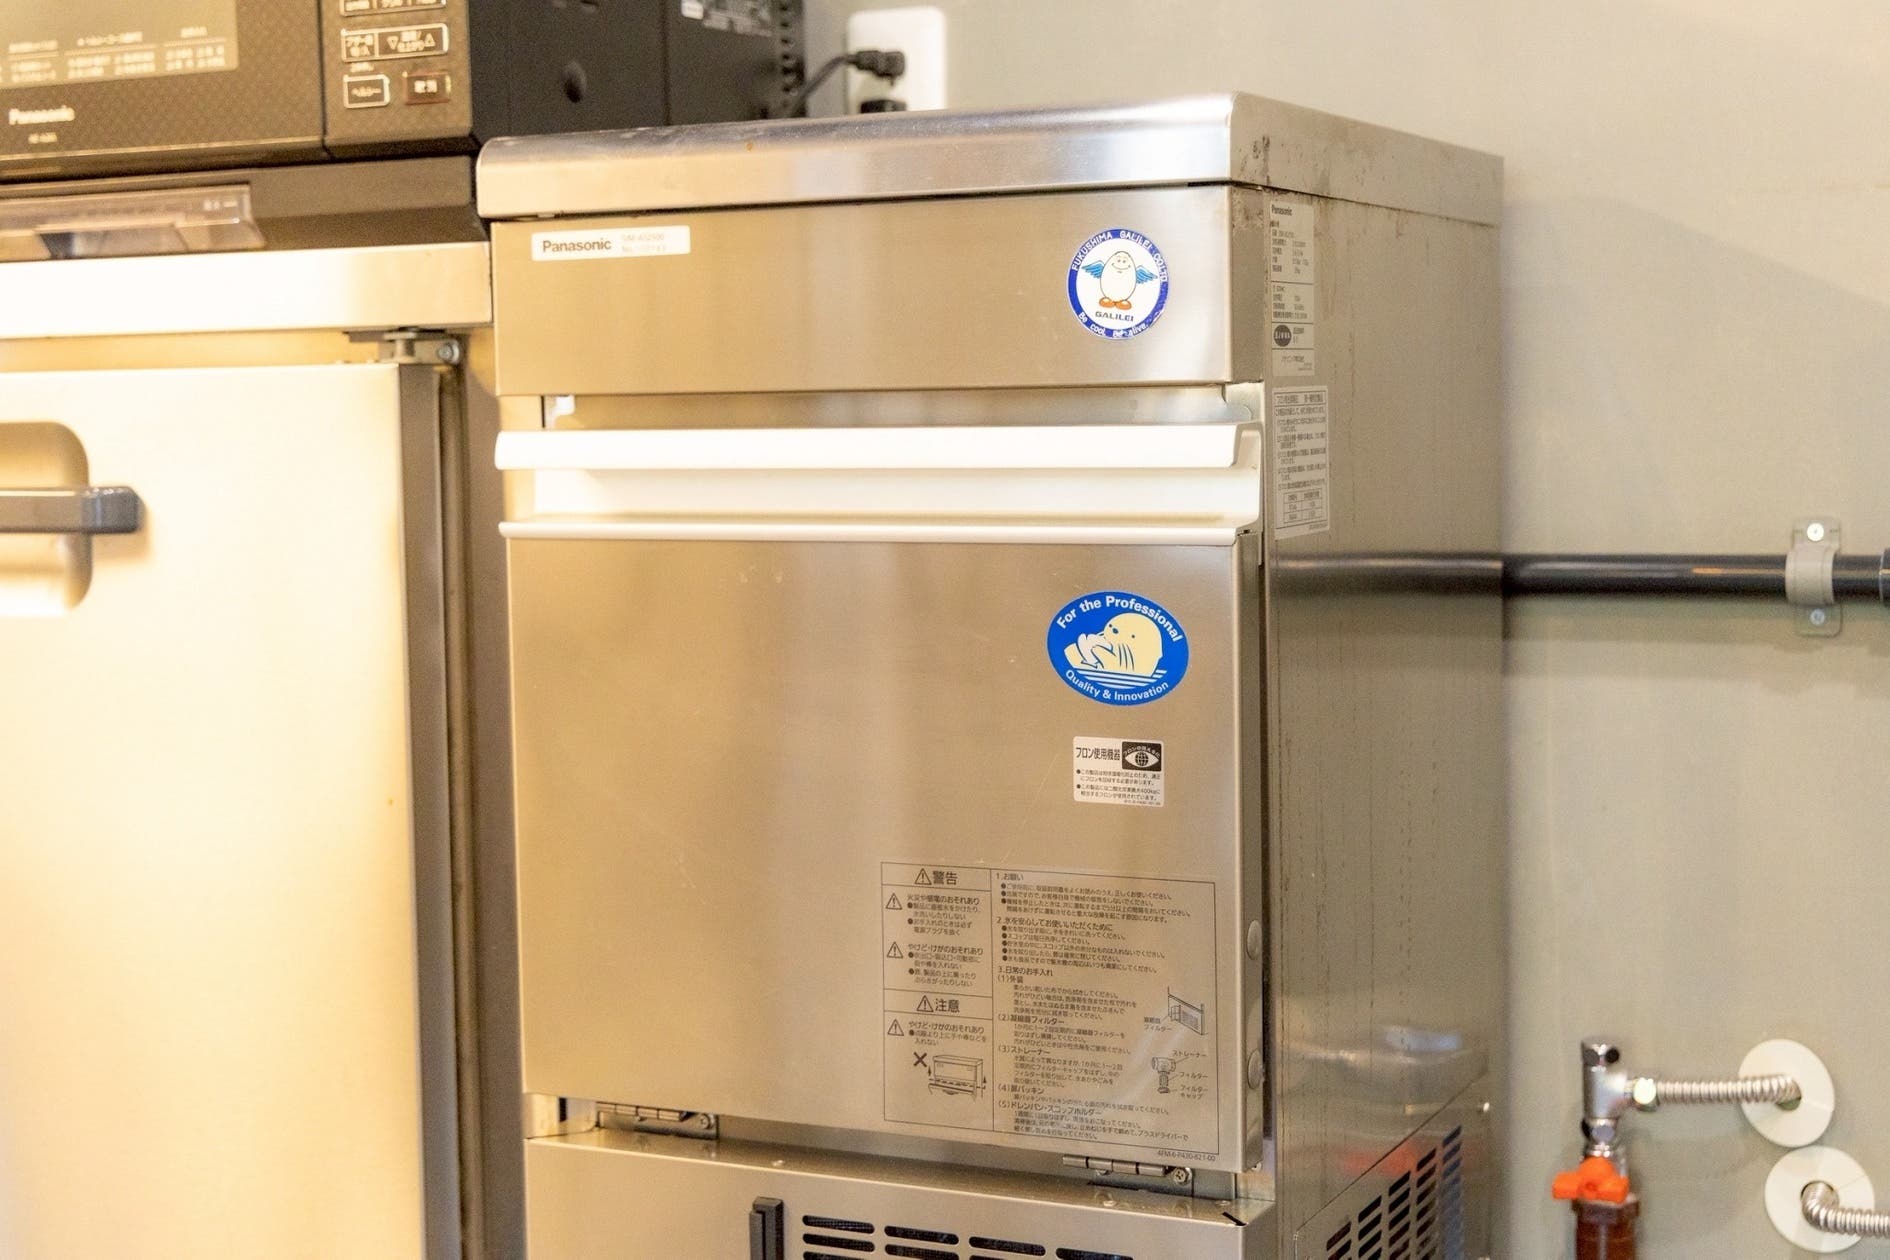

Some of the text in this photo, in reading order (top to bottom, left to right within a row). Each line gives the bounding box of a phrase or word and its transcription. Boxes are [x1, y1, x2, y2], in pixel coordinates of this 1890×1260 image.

[542, 238, 612, 253] Panasonic
[1072, 231, 1113, 271] FUKUSHIMA
[1120, 230, 1152, 250] GALILEI
[1095, 311, 1134, 322] GALILEI
[1056, 595, 1183, 642] For the Professional
[1065, 669, 1169, 701] Quality & Innovation
[1076, 747, 1120, 760] フロン使用機器
[933, 870, 957, 885] 警告
[935, 998, 959, 1012] 注意
